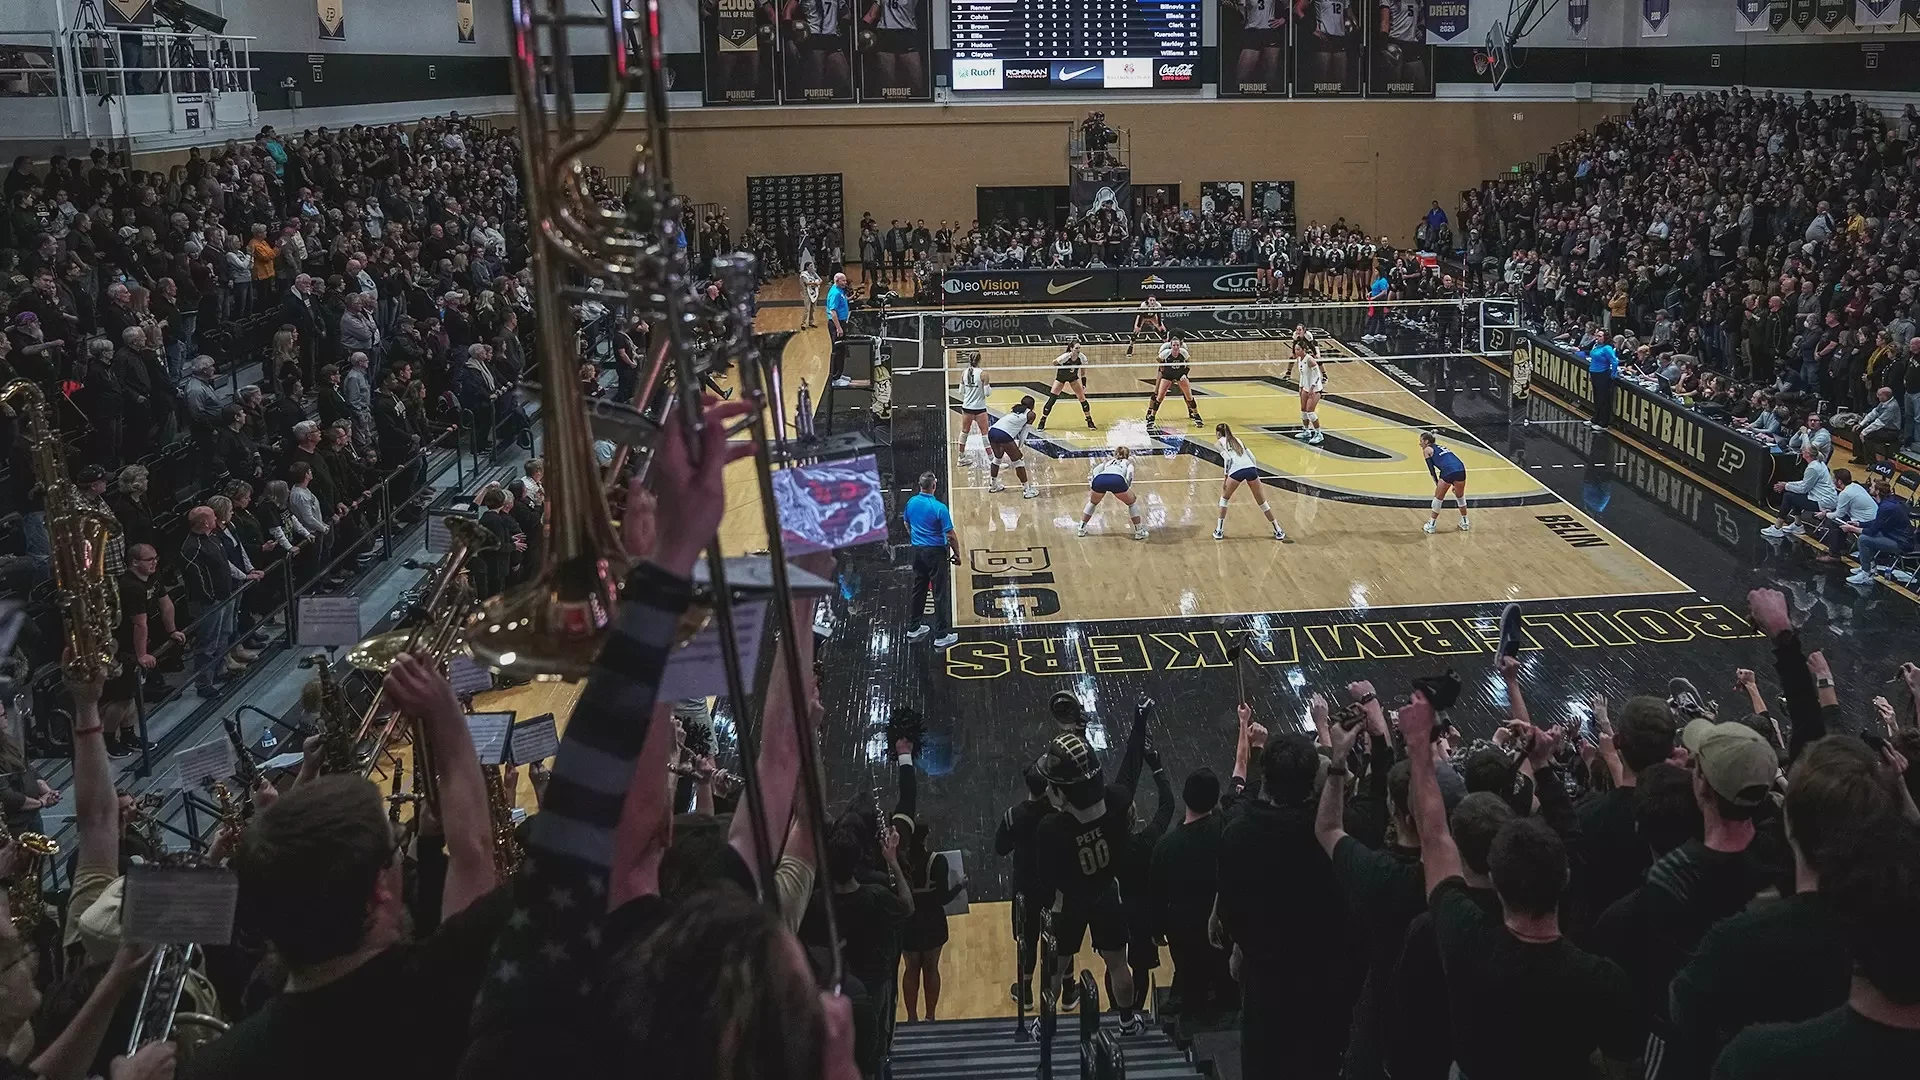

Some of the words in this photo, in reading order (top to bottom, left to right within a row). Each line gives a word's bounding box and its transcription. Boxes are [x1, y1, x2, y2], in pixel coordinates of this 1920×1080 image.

[1430, 5, 1466, 16] DREWS
[970, 68, 996, 76] Ruoff
[1006, 68, 1048, 76] ROHRMAN
[882, 87, 911, 96] PURDUE
[1239, 83, 1267, 92] PURDUE
[726, 90, 755, 99] PURDUE
[804, 88, 834, 97] PURDUE
[191, 118, 195, 126] 3
[953, 279, 1019, 291] NeoVision
[1534, 514, 1610, 548] BELIN
[1076, 828, 1103, 847] PETE
[1078, 838, 1110, 876] 00
